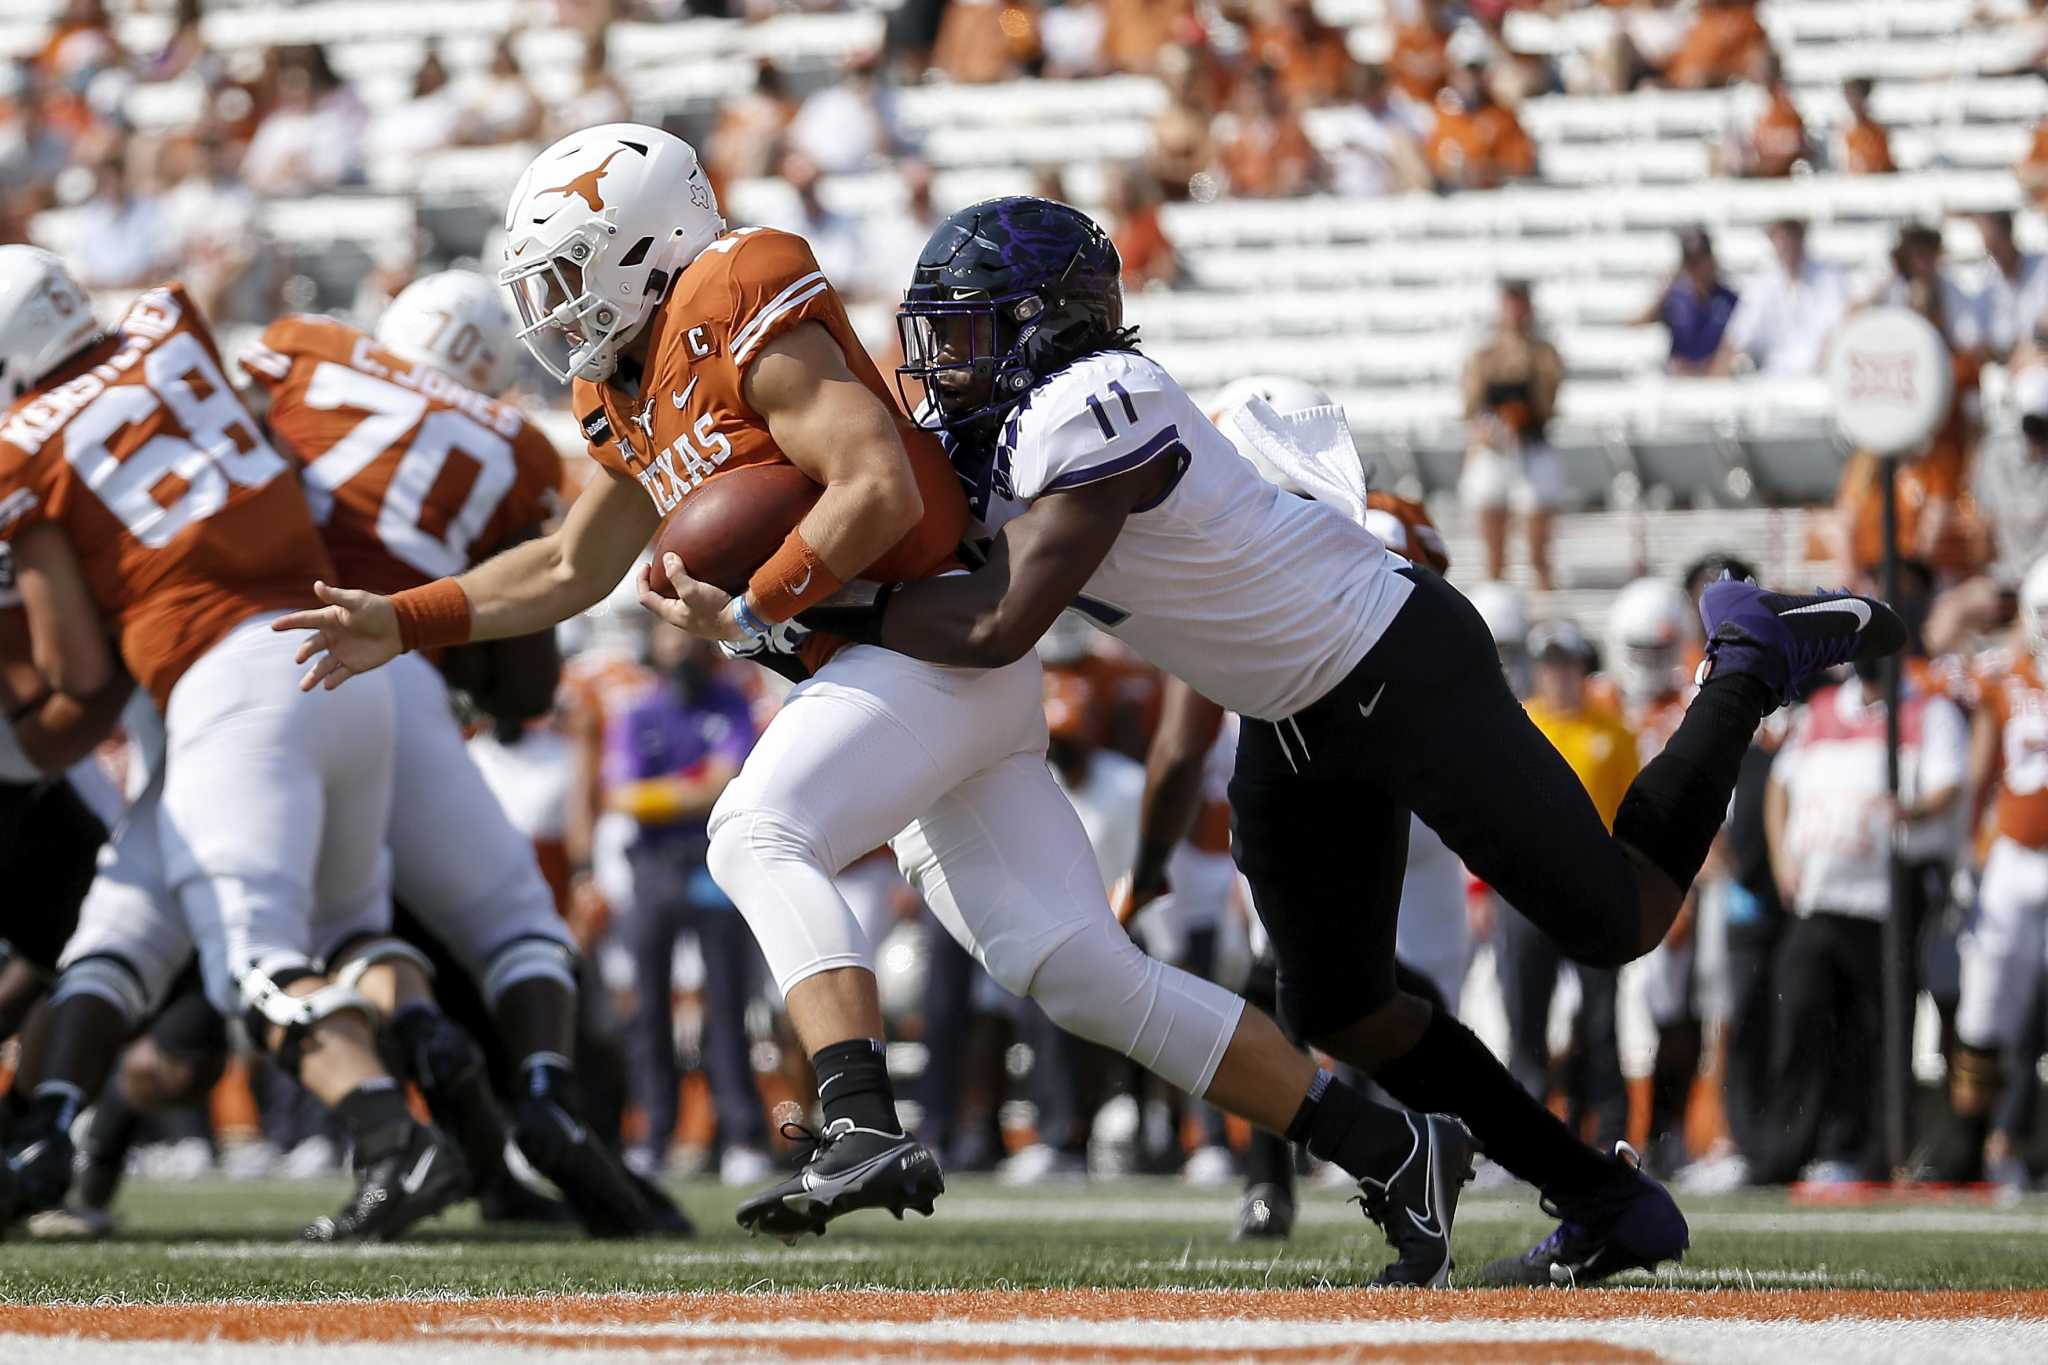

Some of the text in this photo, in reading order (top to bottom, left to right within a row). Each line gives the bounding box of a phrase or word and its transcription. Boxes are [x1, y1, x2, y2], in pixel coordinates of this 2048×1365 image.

[687, 326, 709, 356] C
[62, 331, 289, 550] 68
[637, 411, 733, 518] TEXAS
[1085, 378, 1140, 445] 11
[302, 360, 519, 581] 70
